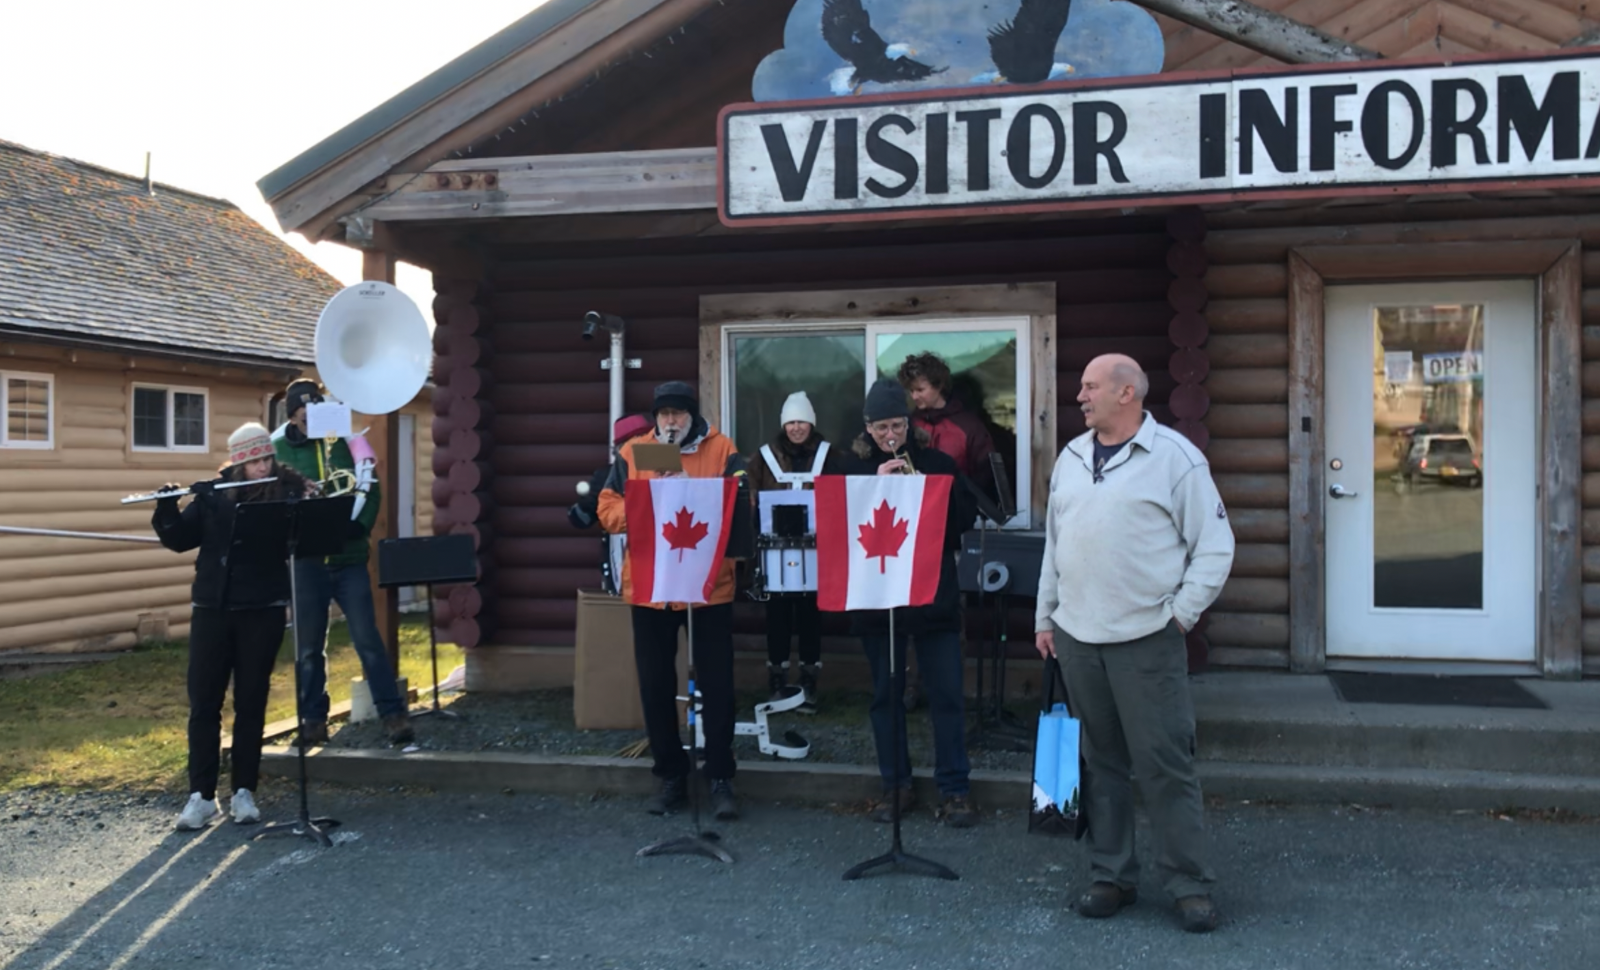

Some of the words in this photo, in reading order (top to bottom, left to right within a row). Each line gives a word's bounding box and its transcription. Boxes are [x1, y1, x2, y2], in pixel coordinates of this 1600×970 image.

[760, 101, 1130, 202] VISITOR
[1199, 71, 1600, 179] INFORM
[1430, 357, 1478, 377] OPEN
